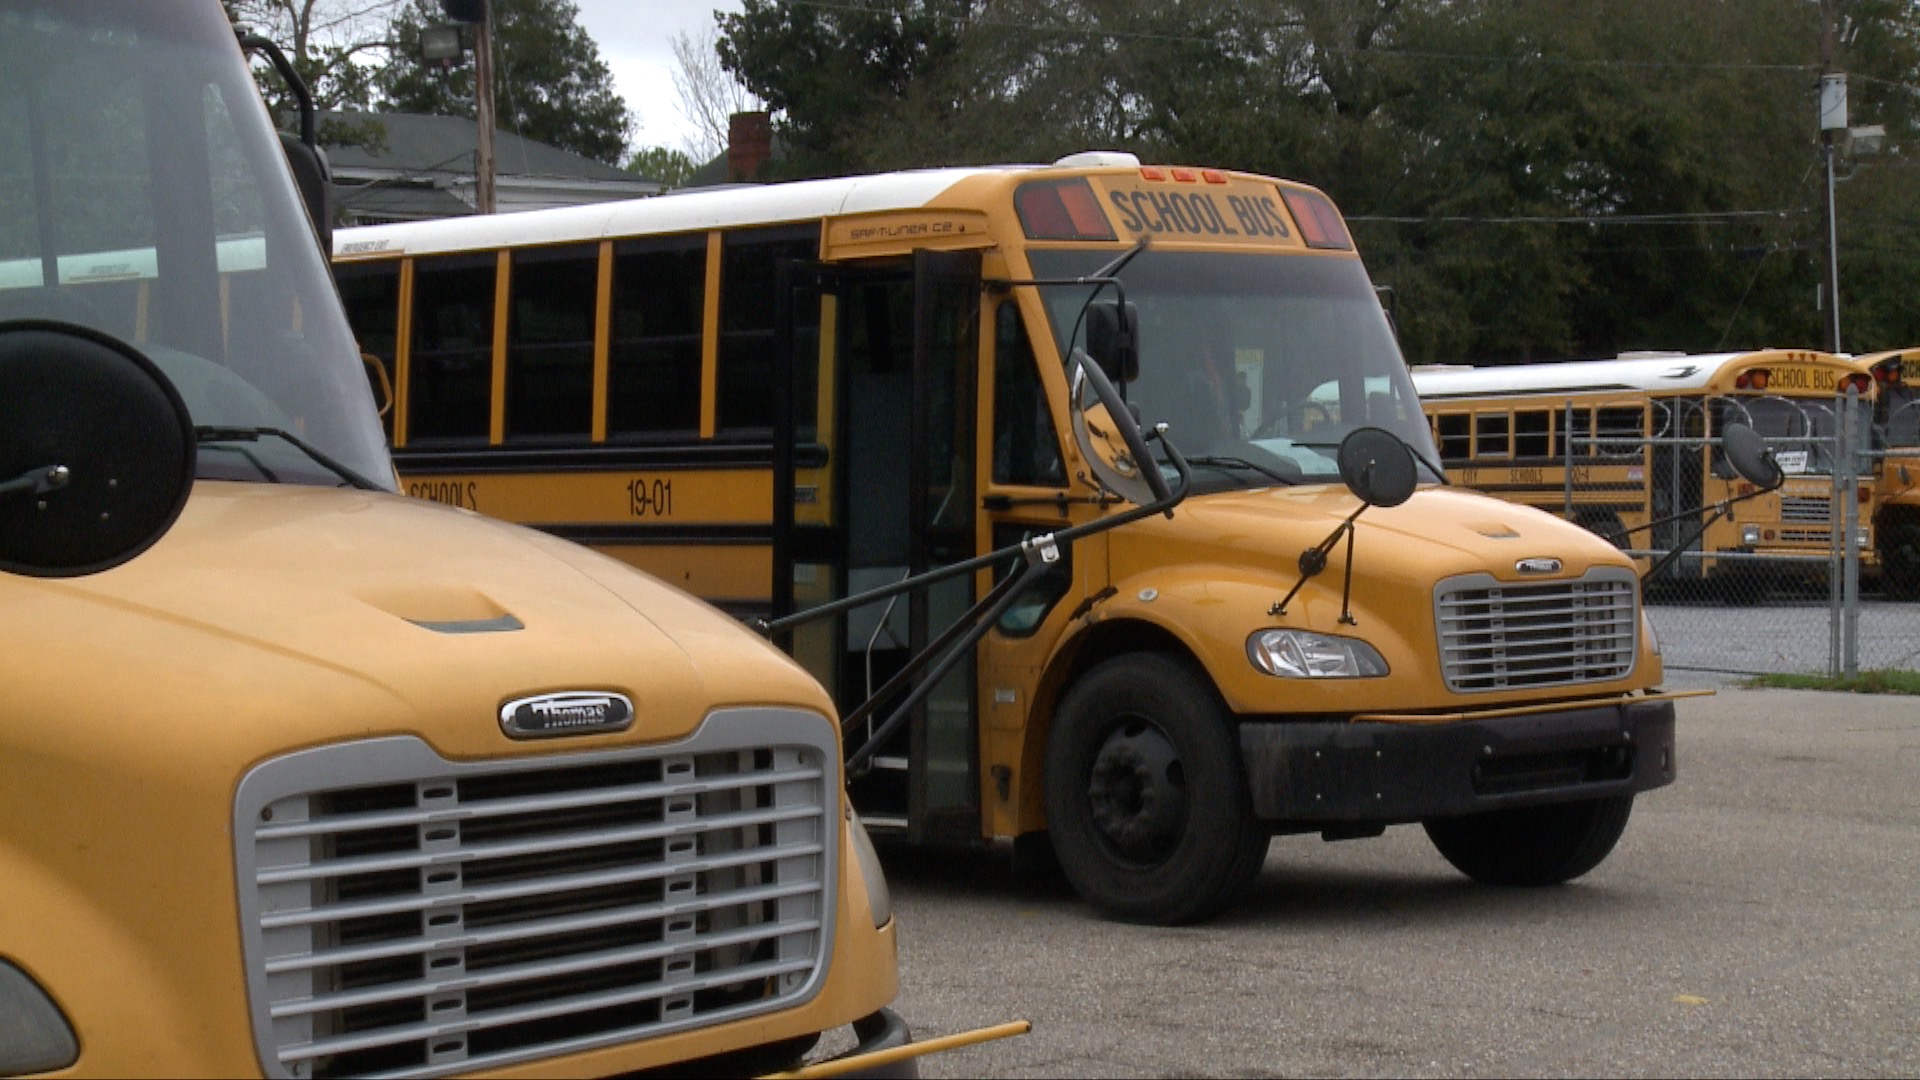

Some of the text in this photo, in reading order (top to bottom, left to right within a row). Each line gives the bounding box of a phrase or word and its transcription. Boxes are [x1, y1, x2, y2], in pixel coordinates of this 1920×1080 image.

[1109, 190, 1290, 239] SCHOOL BUS
[1769, 367, 1835, 390] SCHOOL BUS
[1462, 468, 1544, 483] CITY SCHOOLS
[627, 479, 671, 516] 19-01
[531, 699, 611, 728] Thomas
